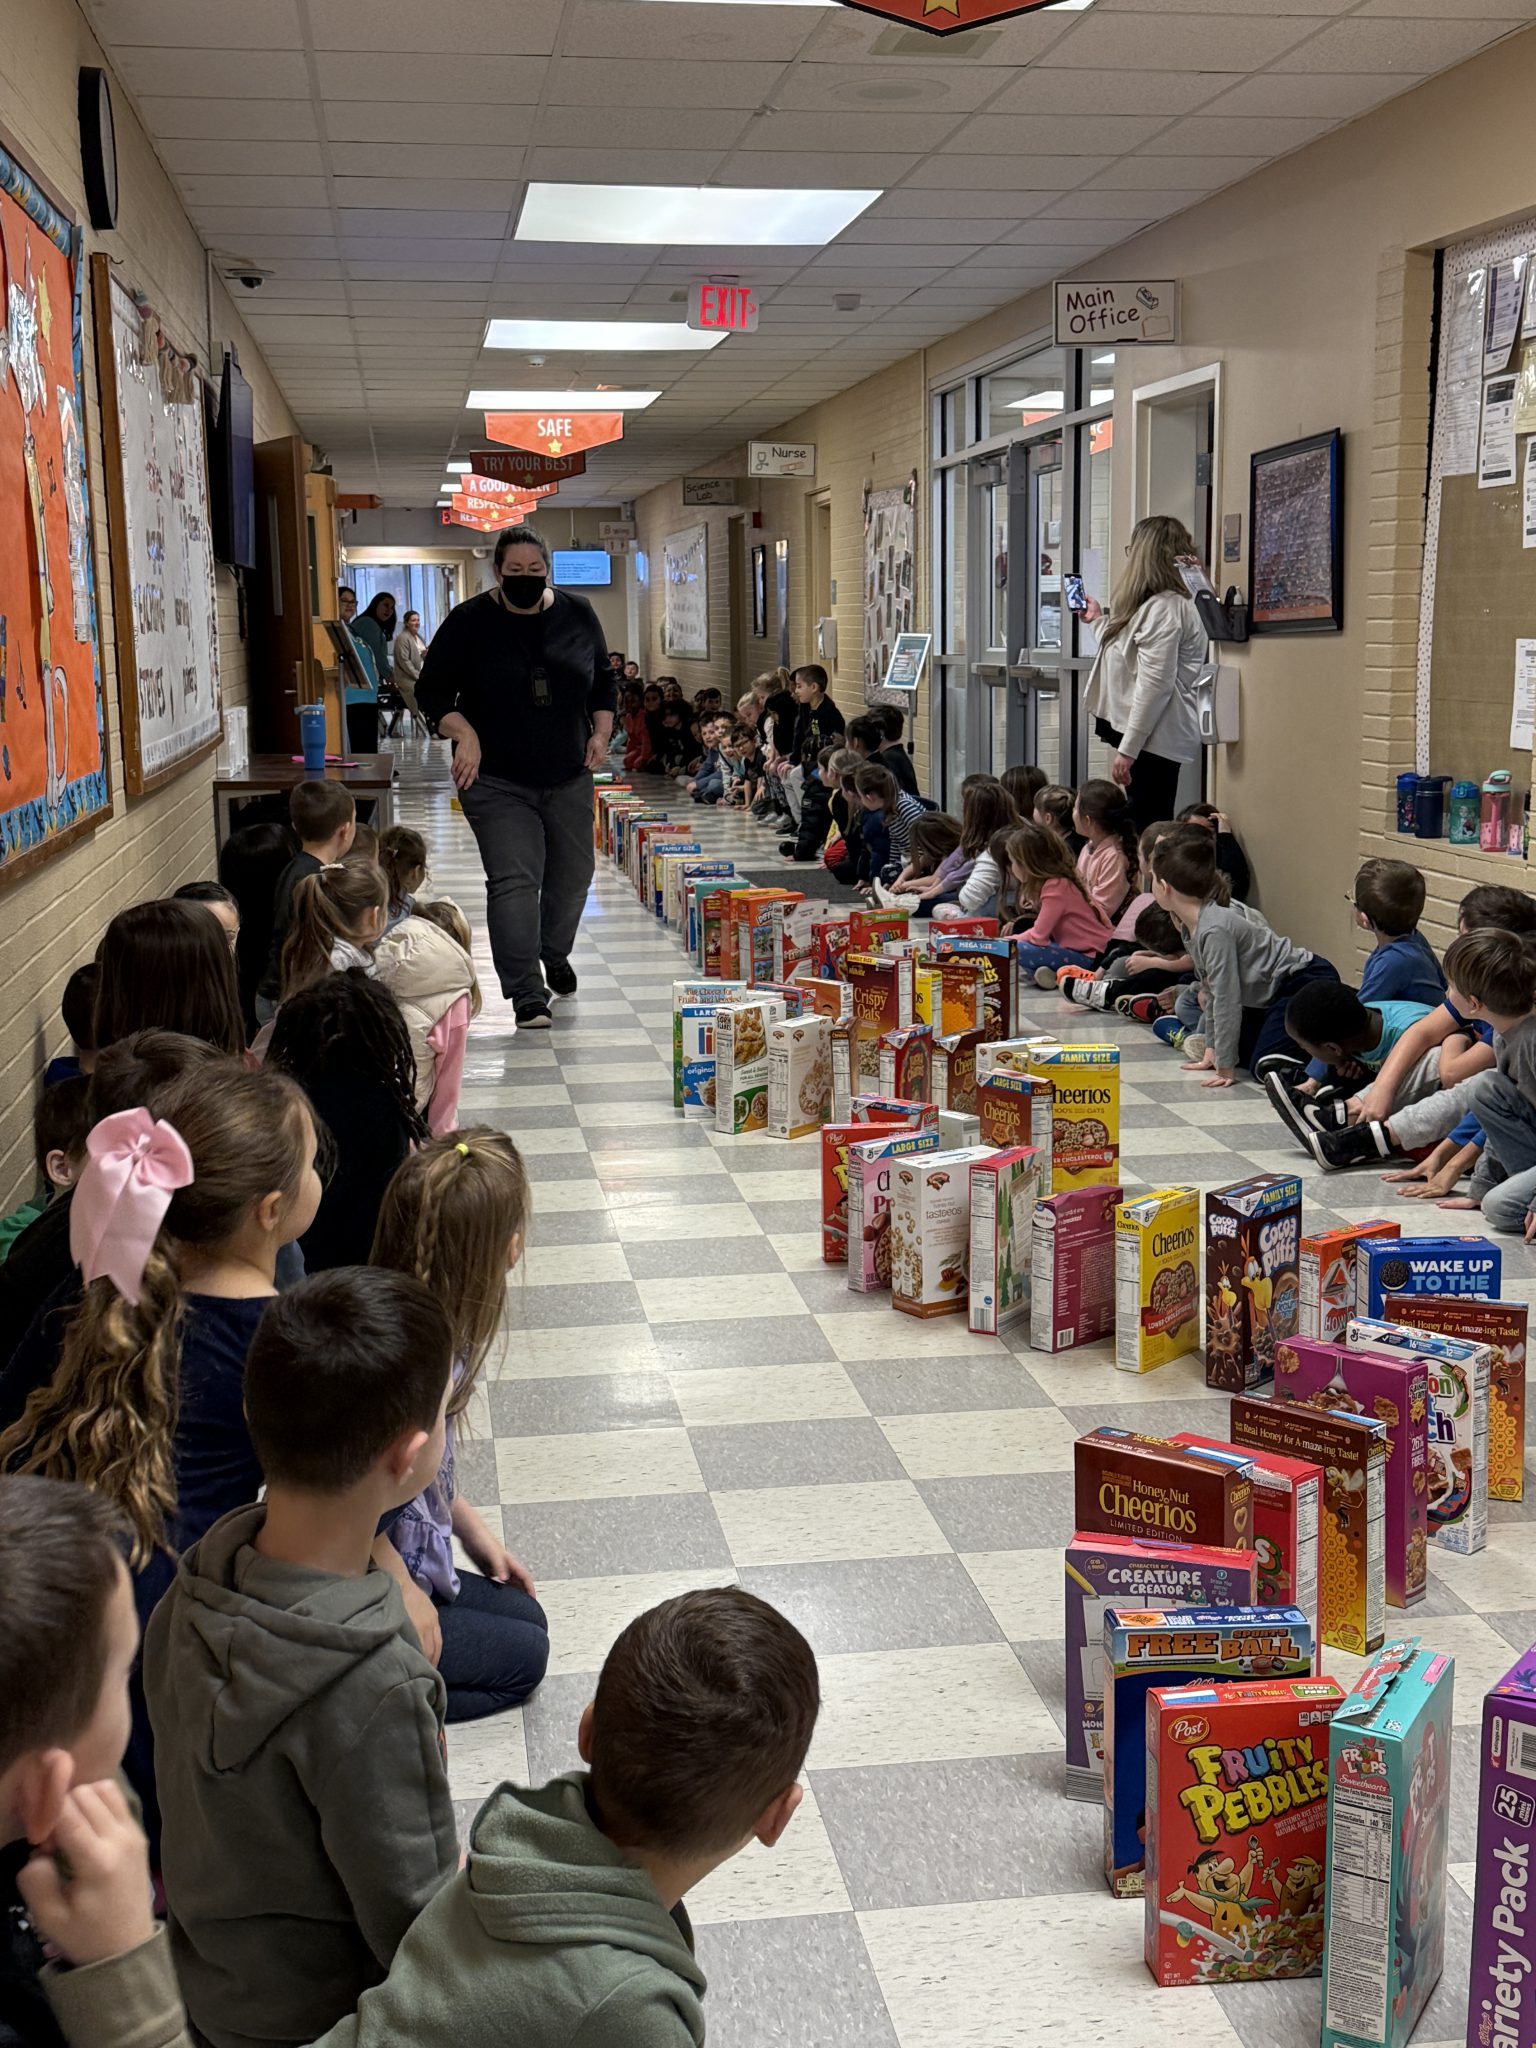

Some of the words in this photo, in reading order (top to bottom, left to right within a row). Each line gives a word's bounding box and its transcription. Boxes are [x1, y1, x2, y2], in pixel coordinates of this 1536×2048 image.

[701, 284, 751, 329] EXIT
[1066, 287, 1115, 312] Main
[1070, 307, 1140, 334] Office
[537, 418, 572, 437] SAFE
[771, 447, 807, 459] Nurse
[482, 456, 504, 471] TRY
[508, 456, 541, 471] YOUR
[544, 456, 574, 471] BEST
[470, 480, 477, 491] A
[479, 480, 510, 491] GOOD
[686, 480, 720, 494] Science
[696, 490, 713, 500] Lab
[854, 987, 887, 1010] Crispy
[857, 1003, 881, 1021] Oats
[954, 1056, 976, 1077] Cheer
[1060, 1054, 1090, 1063] FAMILY
[1092, 1053, 1111, 1063] SIZE
[688, 1065, 715, 1076] original
[992, 1076, 1009, 1089] LARGE
[1010, 1080, 1022, 1092] SIZE
[1053, 1085, 1111, 1105] heerios
[984, 1101, 1021, 1126] Cheerios
[891, 1142, 915, 1154] LARGE
[918, 1138, 934, 1149] SIZE
[1062, 1154, 1102, 1163] CHOLESTEROL
[1263, 1187, 1284, 1205] FAMILY
[1285, 1183, 1297, 1197] SIZE
[1117, 1221, 1139, 1231] Cheerios
[1152, 1225, 1195, 1258] Cheerios
[1410, 1261, 1466, 1273] WAKE
[1468, 1260, 1494, 1273] UP
[1412, 1275, 1443, 1291] TO
[1452, 1274, 1490, 1290] THE
[1400, 1318, 1415, 1328] Real
[1418, 1321, 1441, 1332] Honey
[1443, 1321, 1453, 1332] for
[1455, 1324, 1497, 1337] A-maze-ing
[1498, 1327, 1520, 1337] Taste!
[1243, 1423, 1258, 1436] Real
[1260, 1427, 1282, 1442] Honey
[1284, 1434, 1294, 1445] for
[1338, 1447, 1359, 1461] Taste!
[1132, 1479, 1167, 1500] Honey
[1169, 1488, 1190, 1505] Nut
[1230, 1485, 1250, 1504] Cheerios
[1099, 1483, 1197, 1534] Cheerios
[1110, 1518, 1144, 1534] LIMITED
[1146, 1526, 1182, 1543] EDITION
[1107, 1568, 1202, 1586] CREATURE
[1129, 1583, 1184, 1596] CREATOR
[1233, 1628, 1289, 1639] SPORTS
[1128, 1633, 1219, 1658] FREE
[1221, 1637, 1300, 1661] BALL
[1174, 1720, 1204, 1738] Post
[1340, 1774, 1387, 1792] Sweethearts
[1180, 1759, 1328, 1844] PEBBLES
[1300, 1807, 1313, 1818] RICE
[1313, 1803, 1327, 1815] CEREA
[1498, 1788, 1518, 1819] 25
[1519, 1799, 1527, 1820] mini
[1276, 1824, 1297, 1837] NATURAL
[1302, 1823, 1316, 1835] FRUIT
[1492, 1836, 1530, 1938] Pack
